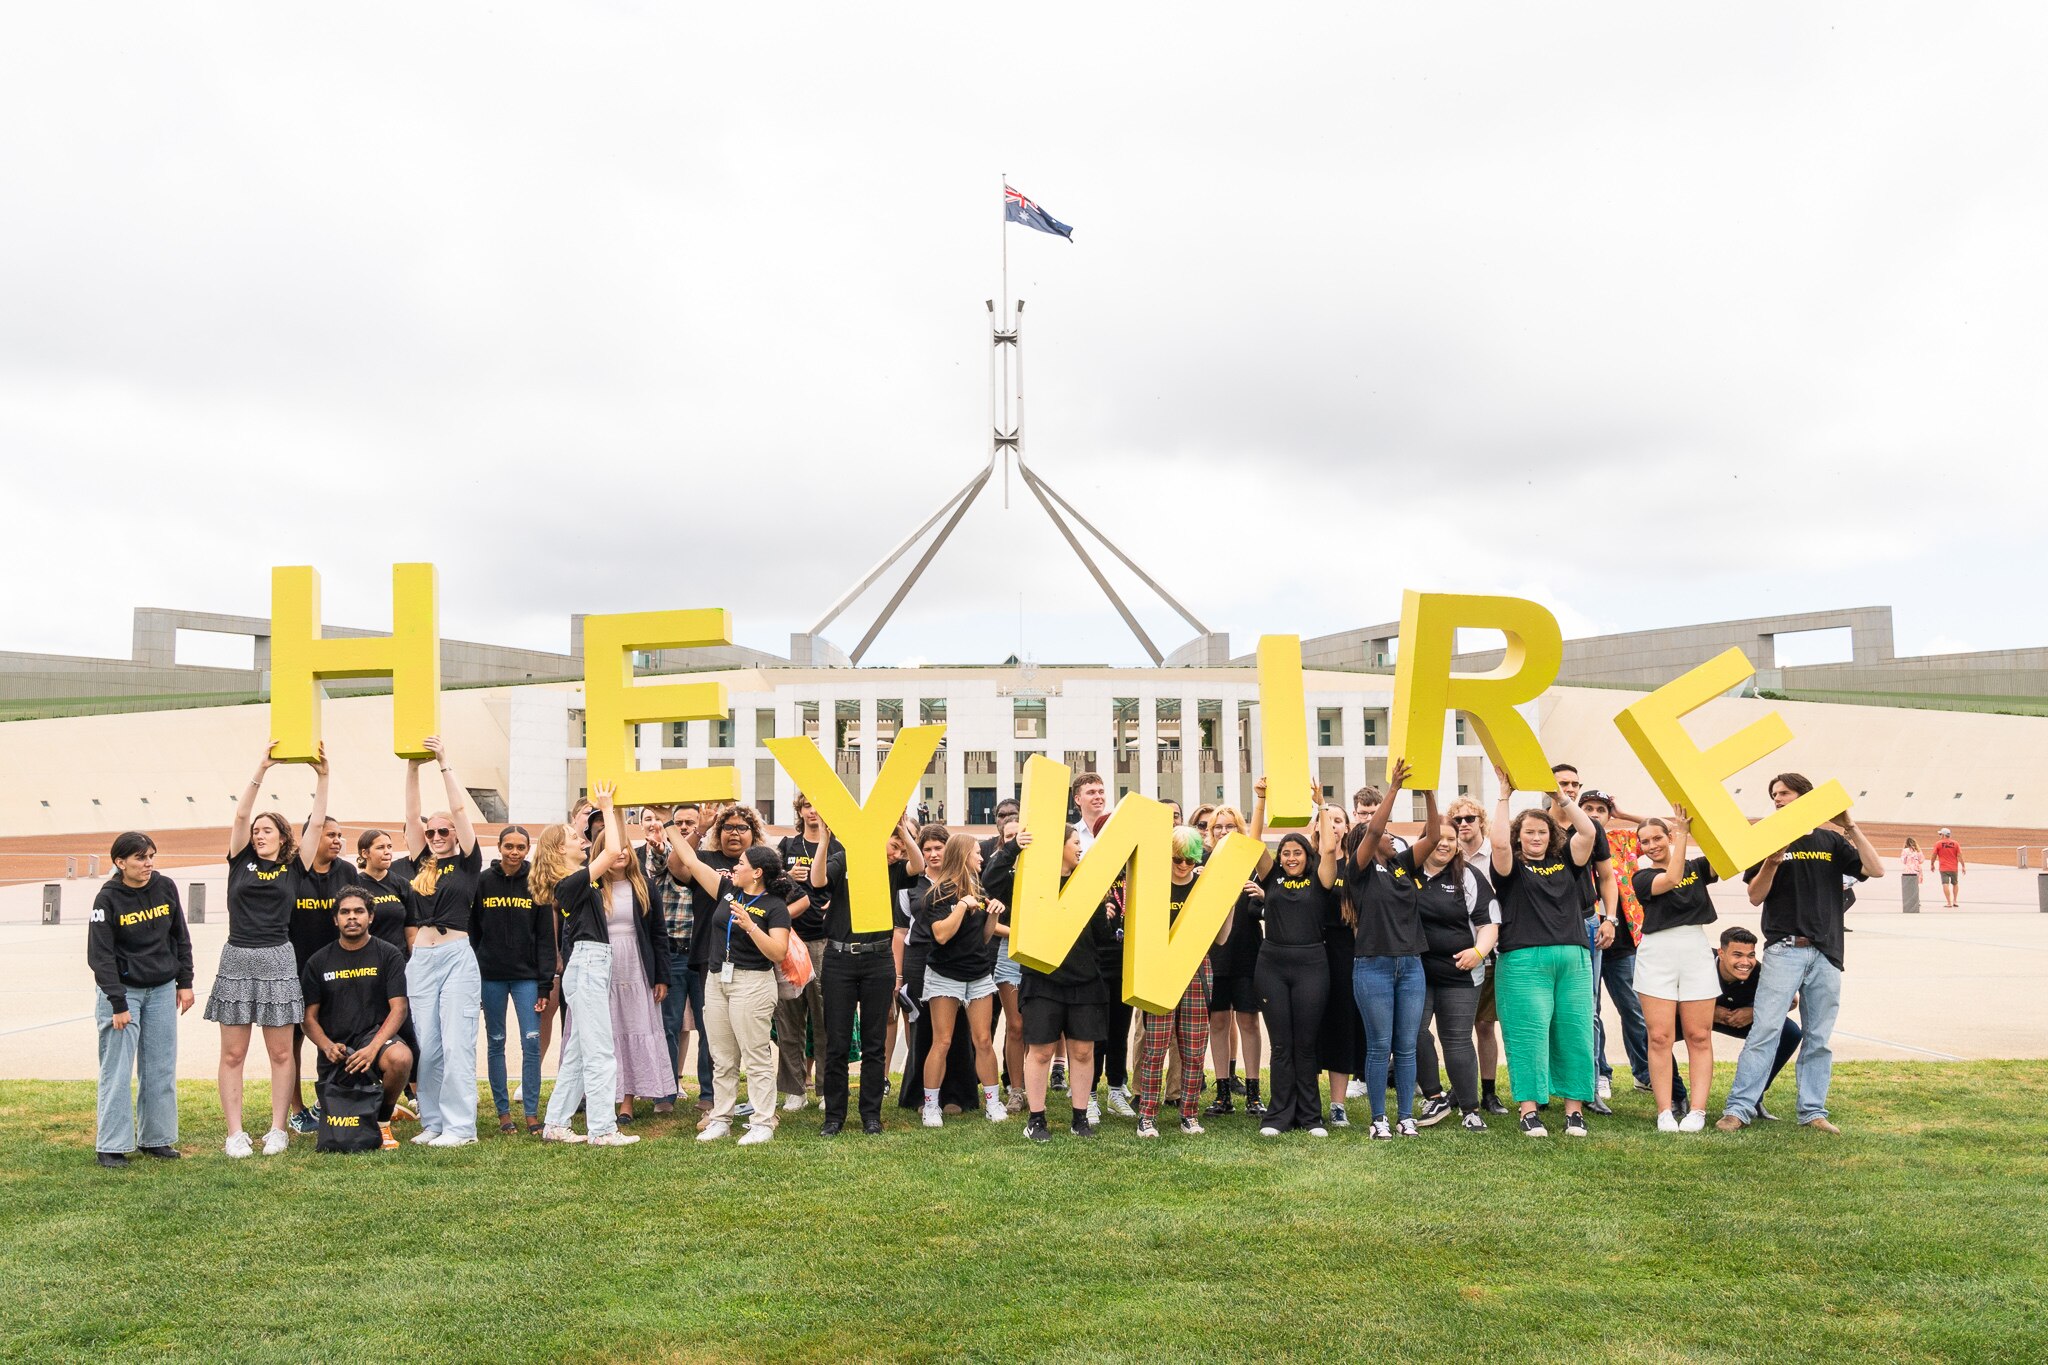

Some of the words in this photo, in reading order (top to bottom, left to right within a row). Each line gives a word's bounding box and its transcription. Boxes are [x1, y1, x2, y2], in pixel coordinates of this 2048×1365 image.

[271, 562, 1854, 1015] HEYWIRE
[1792, 851, 1832, 861] HEYWIRE
[297, 898, 335, 909] HEYWI
[483, 897, 532, 908] HEYWIRE
[120, 904, 169, 926] HEYWIRE
[336, 967, 377, 979] HEYWIRE
[326, 1115, 360, 1127] YWIRE
